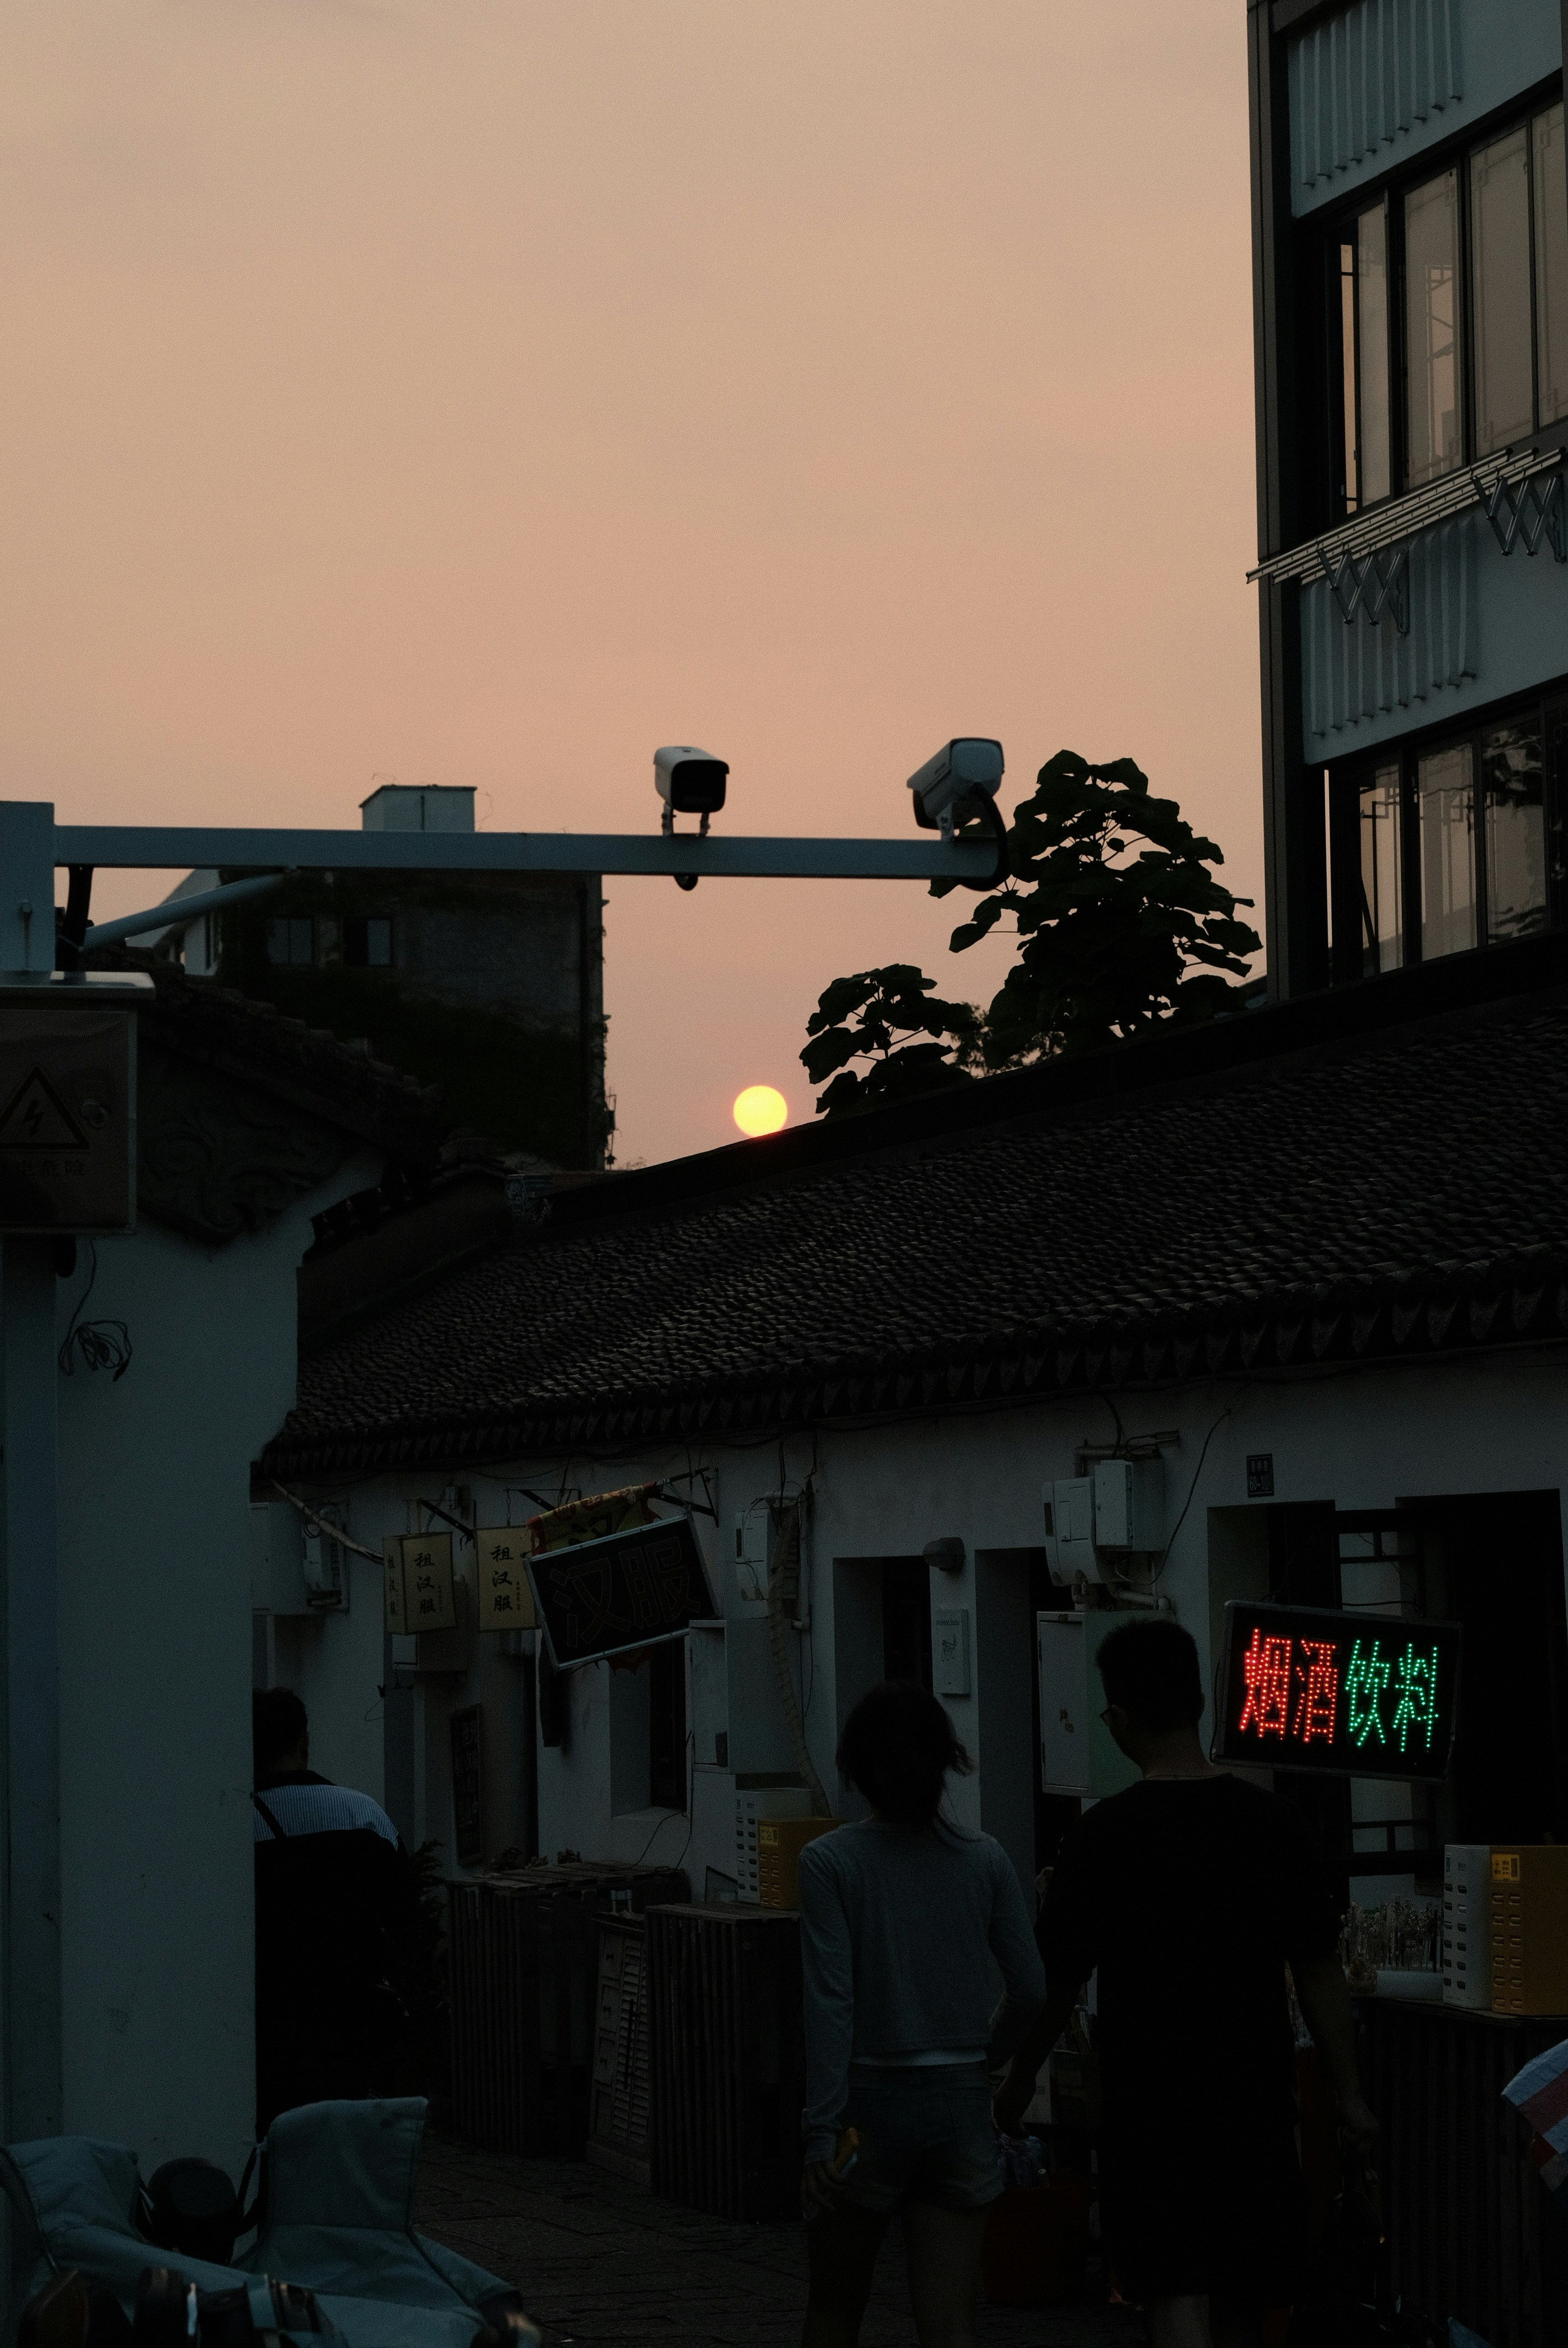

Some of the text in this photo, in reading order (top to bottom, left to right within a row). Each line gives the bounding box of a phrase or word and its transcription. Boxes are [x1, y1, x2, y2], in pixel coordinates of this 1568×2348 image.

[414, 1552, 436, 1614] 租汉服
[490, 1546, 513, 1611] 租汉服
[549, 1536, 701, 1647] 汉服
[1240, 1628, 1440, 1753] 烟酒饮料
